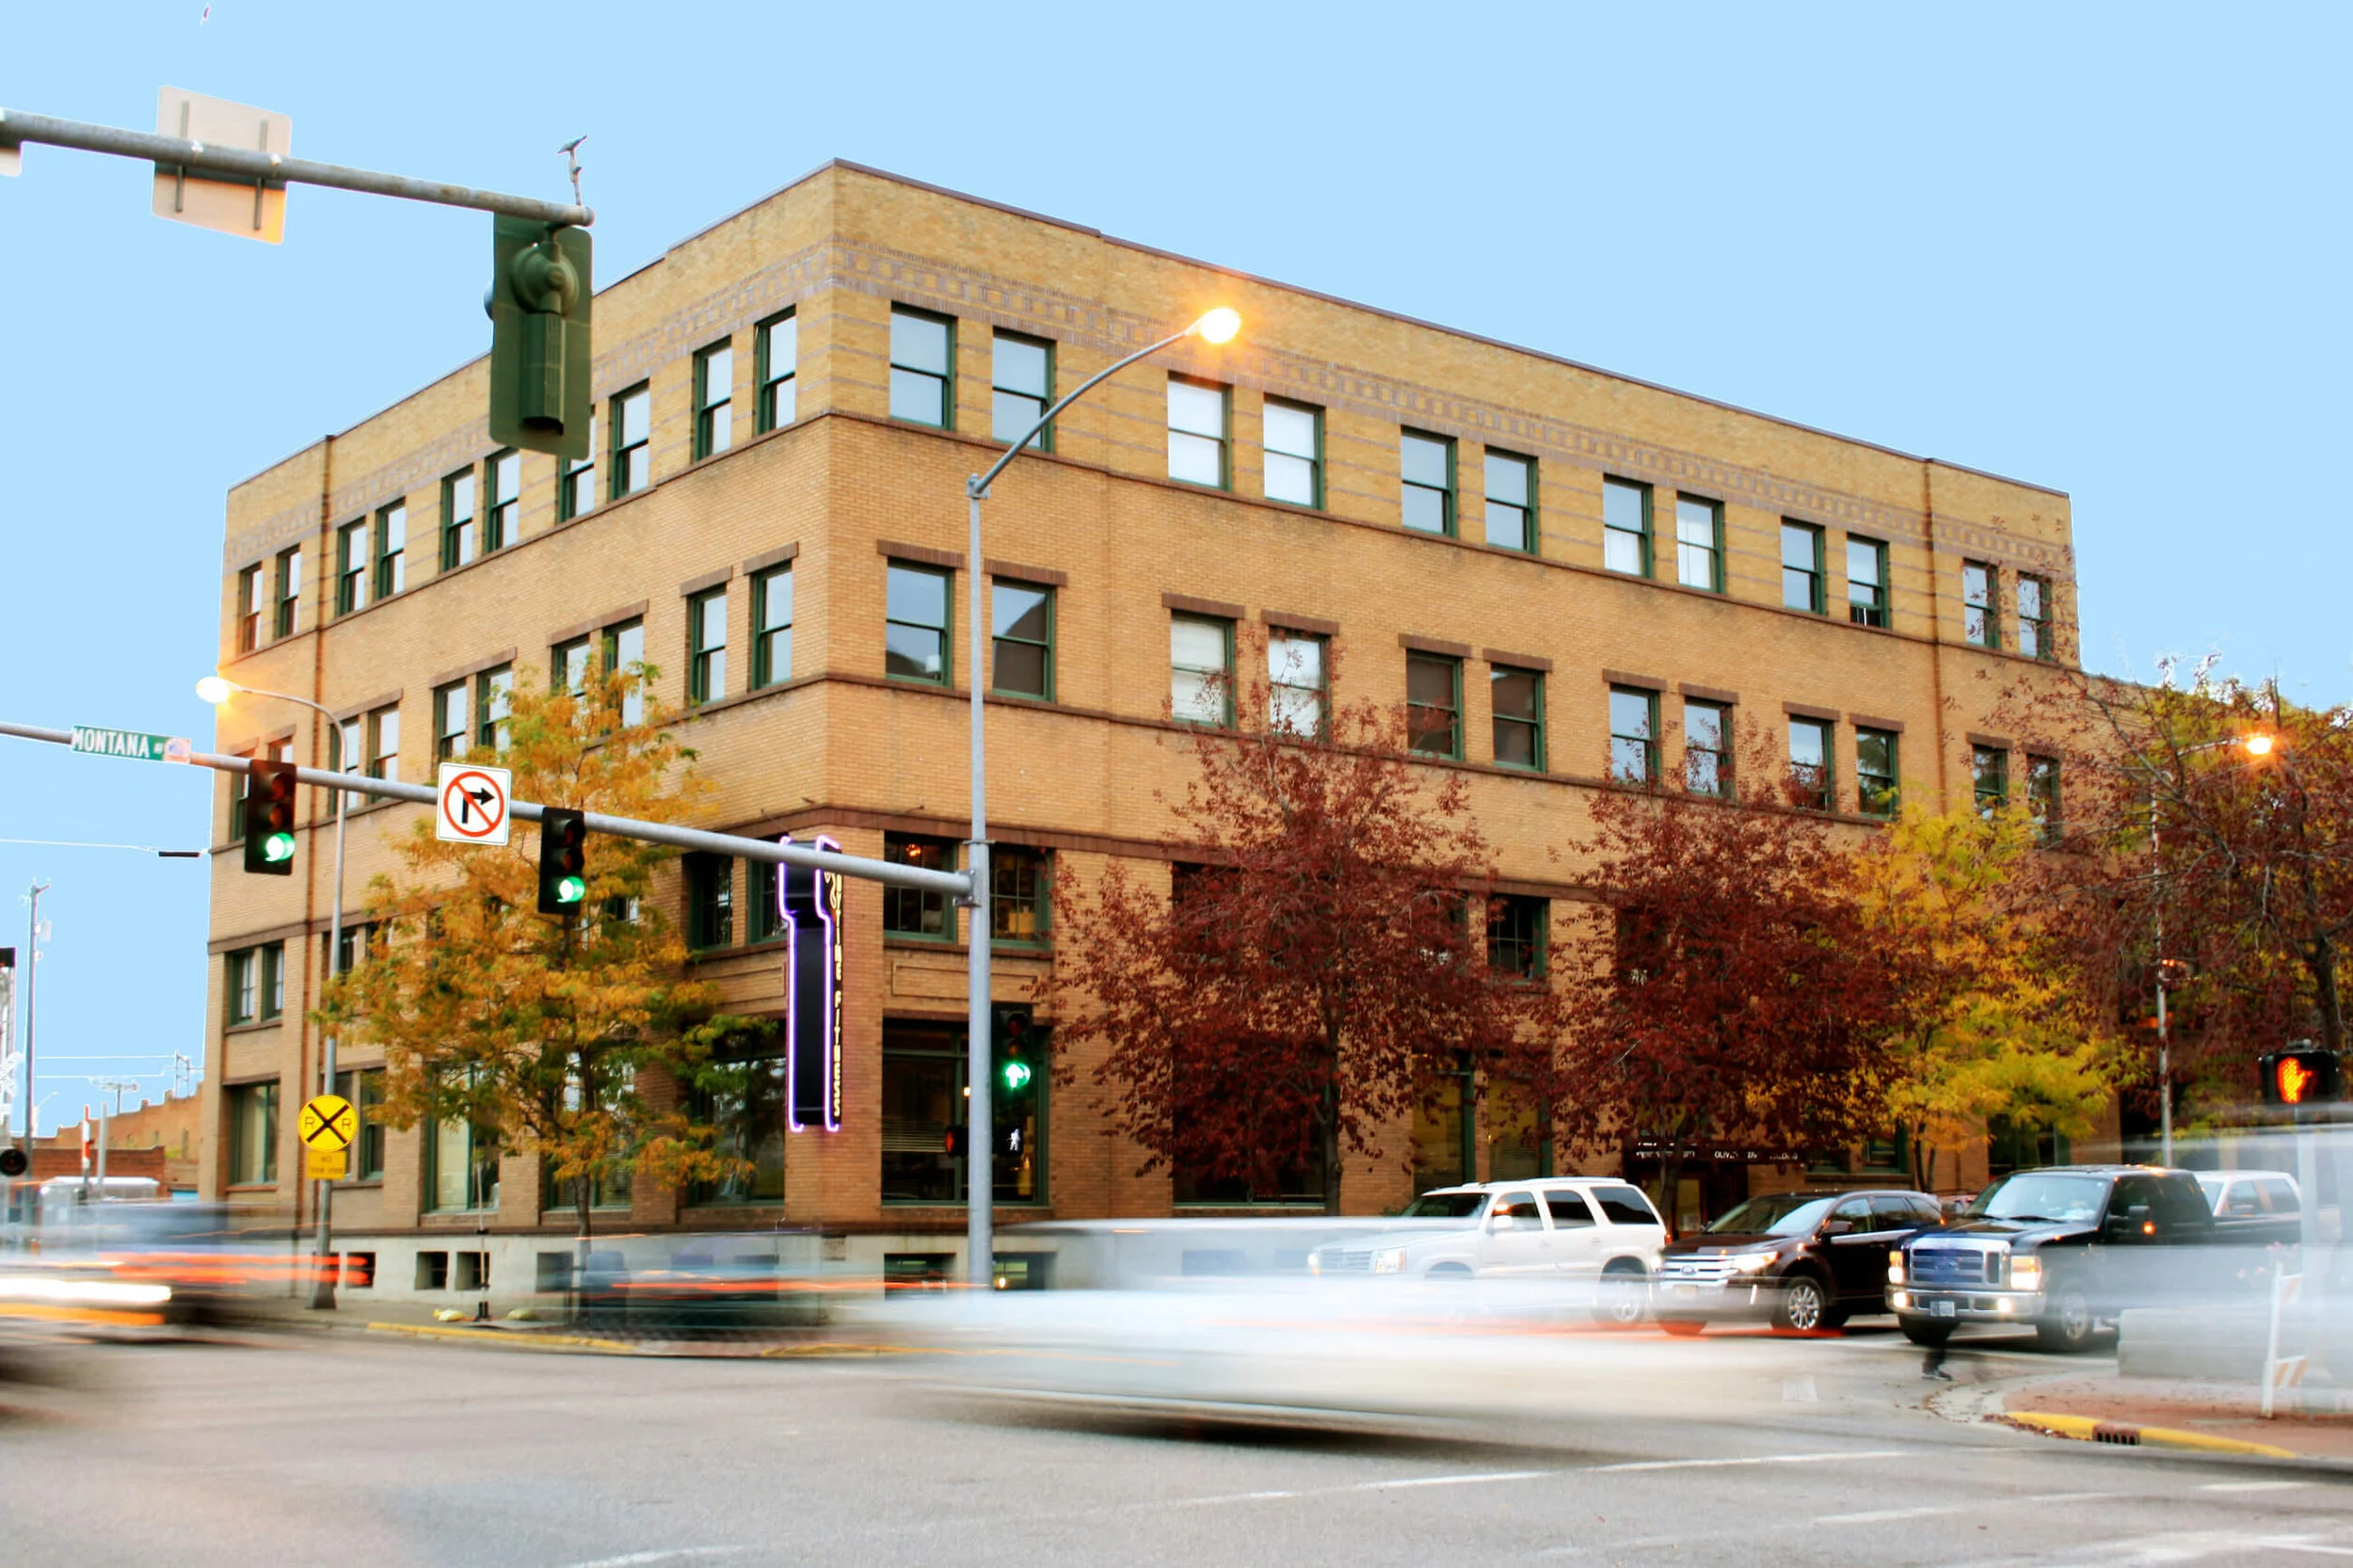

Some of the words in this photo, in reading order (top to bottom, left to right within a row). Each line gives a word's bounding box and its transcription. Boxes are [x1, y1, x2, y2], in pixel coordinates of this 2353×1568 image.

[72, 727, 150, 758] MONTANA
[833, 990, 842, 1117] FITNESS
[304, 1116, 315, 1130] R
[342, 1117, 352, 1131] R
